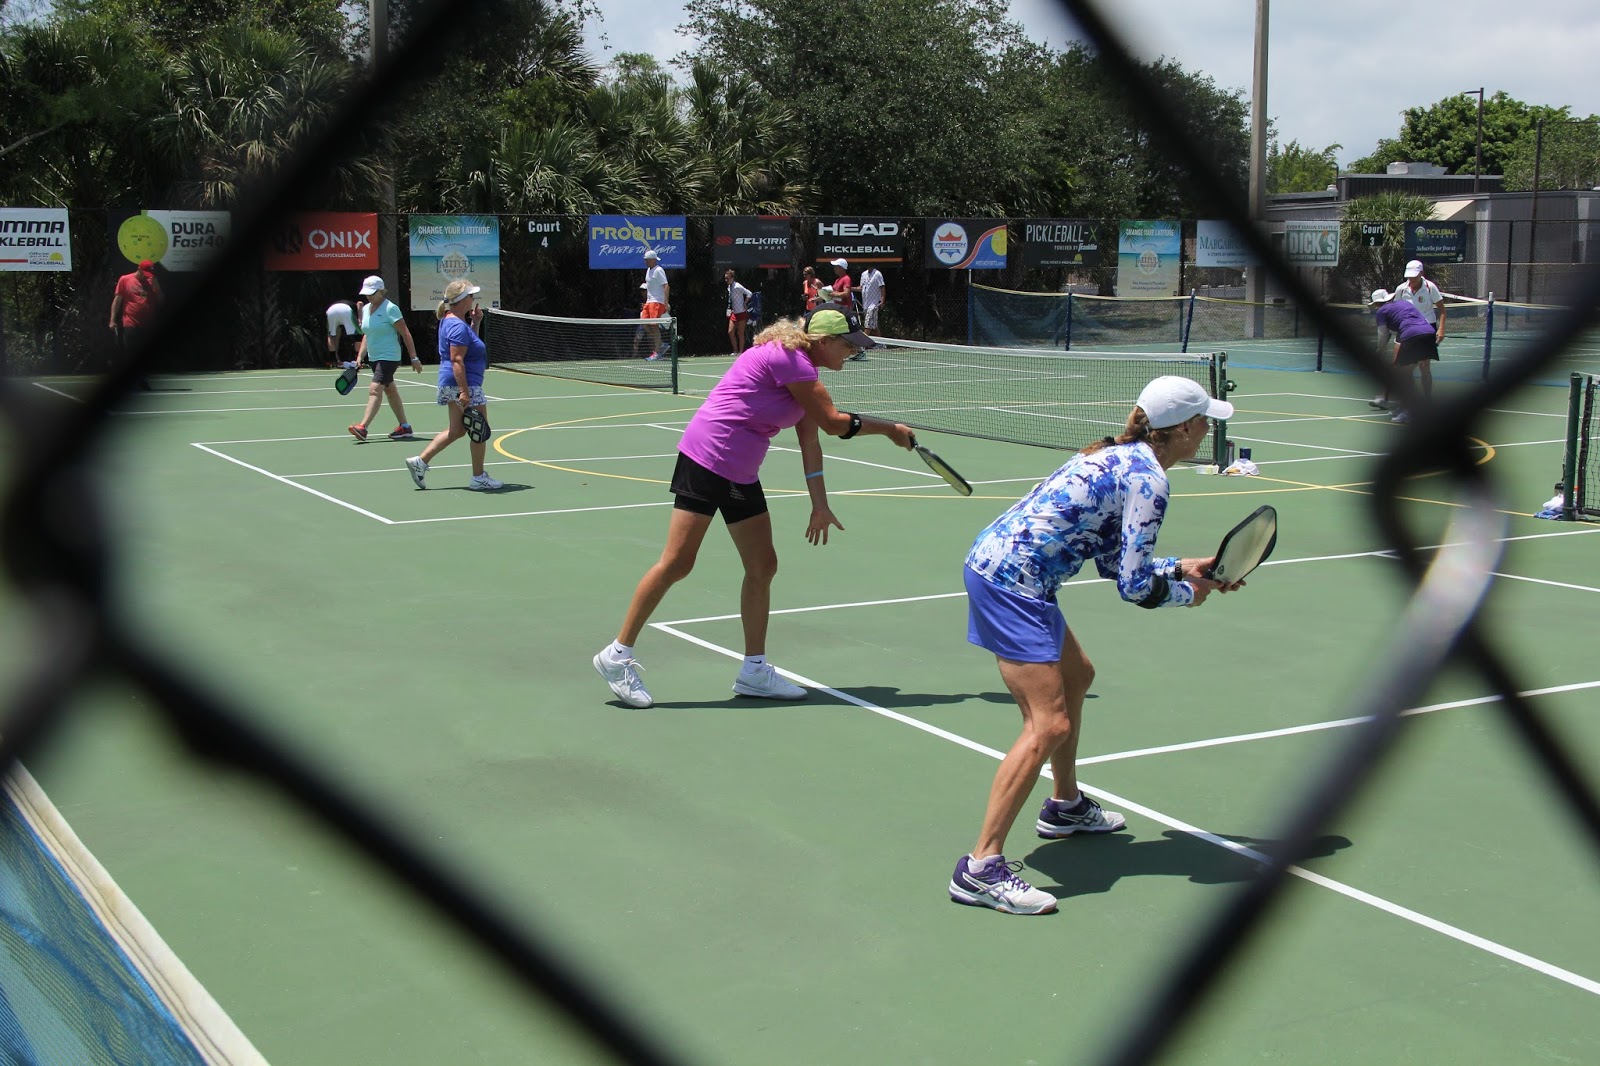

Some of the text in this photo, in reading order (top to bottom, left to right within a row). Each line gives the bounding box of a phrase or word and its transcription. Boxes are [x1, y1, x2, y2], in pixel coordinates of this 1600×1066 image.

[0, 221, 64, 233] MMA
[171, 222, 216, 234] DURA
[418, 226, 490, 234] CHANGE YOUR LATITUDE
[528, 221, 561, 233] Court
[818, 222, 899, 236] HEAD
[1362, 224, 1383, 234] Court
[308, 229, 371, 249] ONIX
[541, 237, 548, 247] 4
[1289, 232, 1336, 254] DICK'S
[1369, 238, 1375, 246] 3
